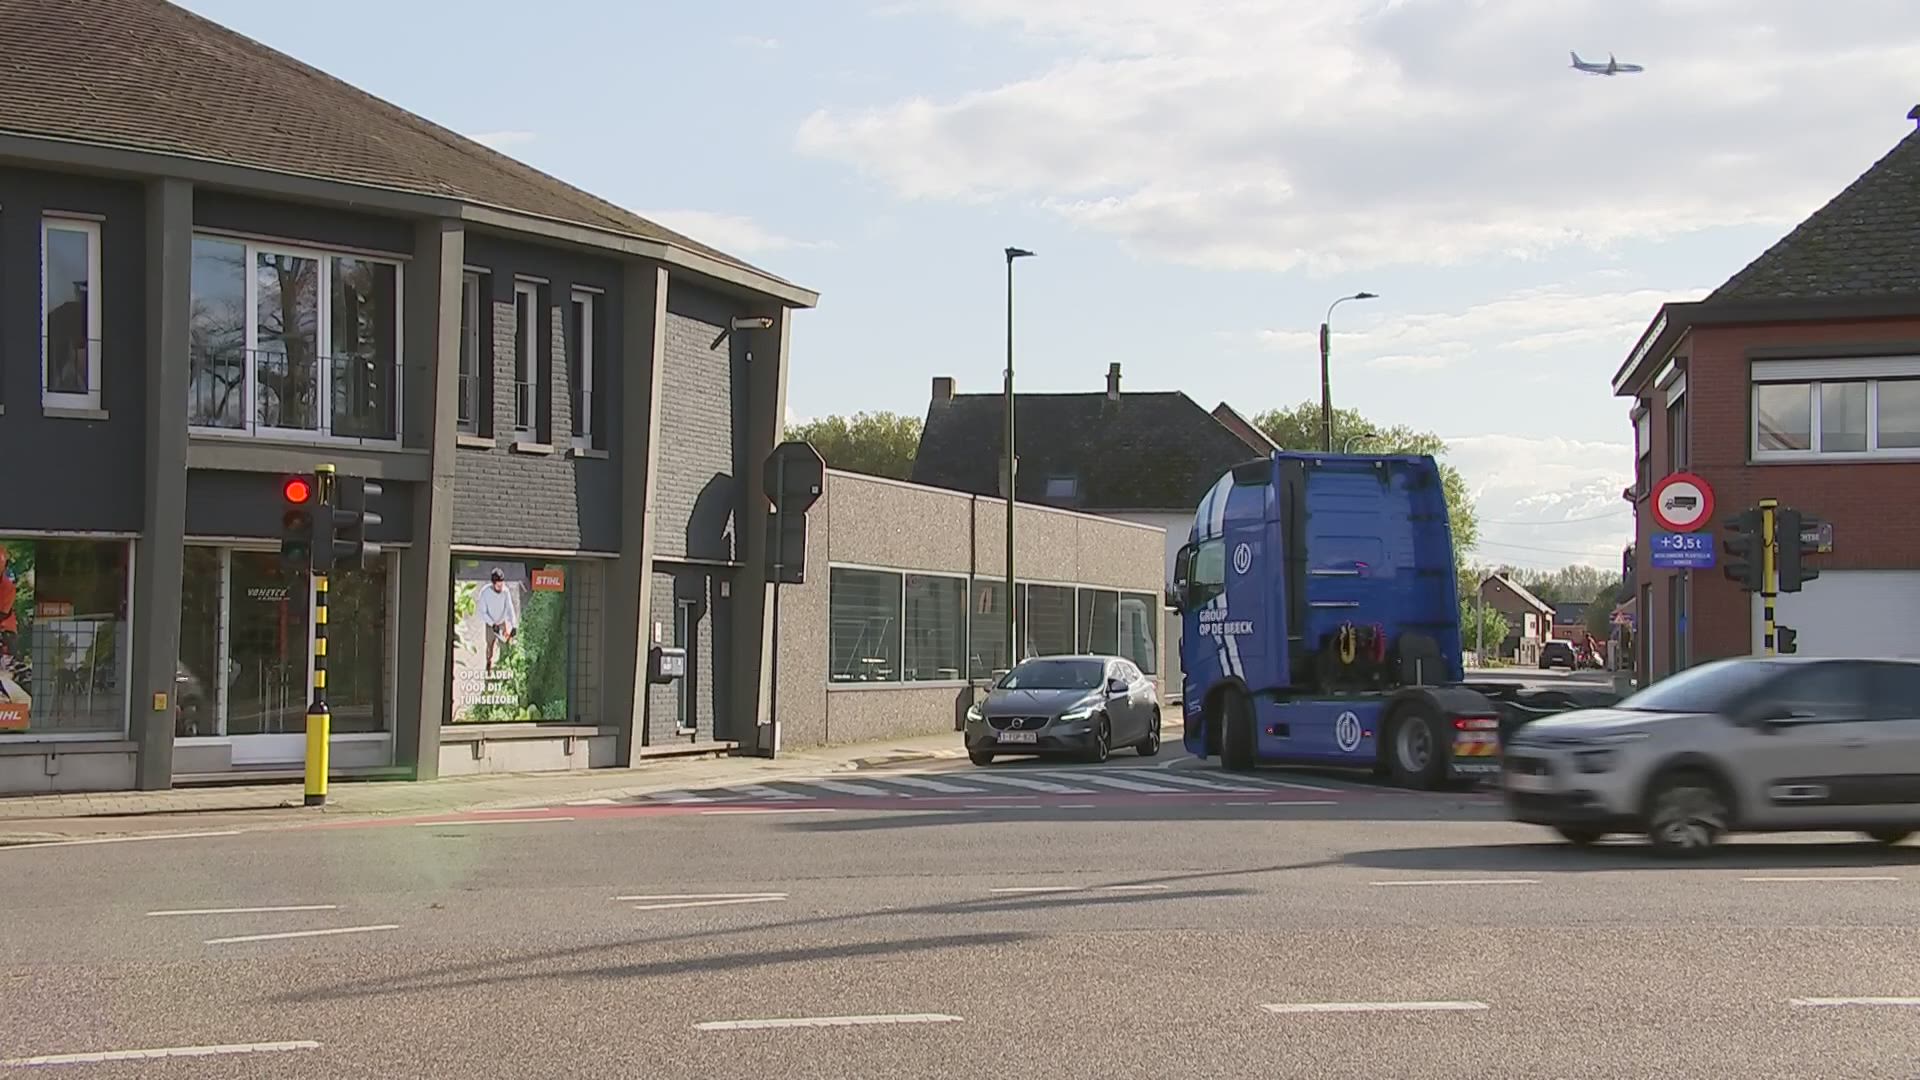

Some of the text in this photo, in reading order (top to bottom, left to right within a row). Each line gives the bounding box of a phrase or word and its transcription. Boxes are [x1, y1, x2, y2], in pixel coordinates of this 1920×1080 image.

[536, 576, 560, 585] STIHL
[1200, 609, 1227, 621] GROUP
[1200, 621, 1253, 635] OP DE BEECK
[460, 670, 514, 680] OPGELADEN
[461, 682, 502, 692] VOOR DIT
[461, 695, 519, 705] TUINSEIZOEN
